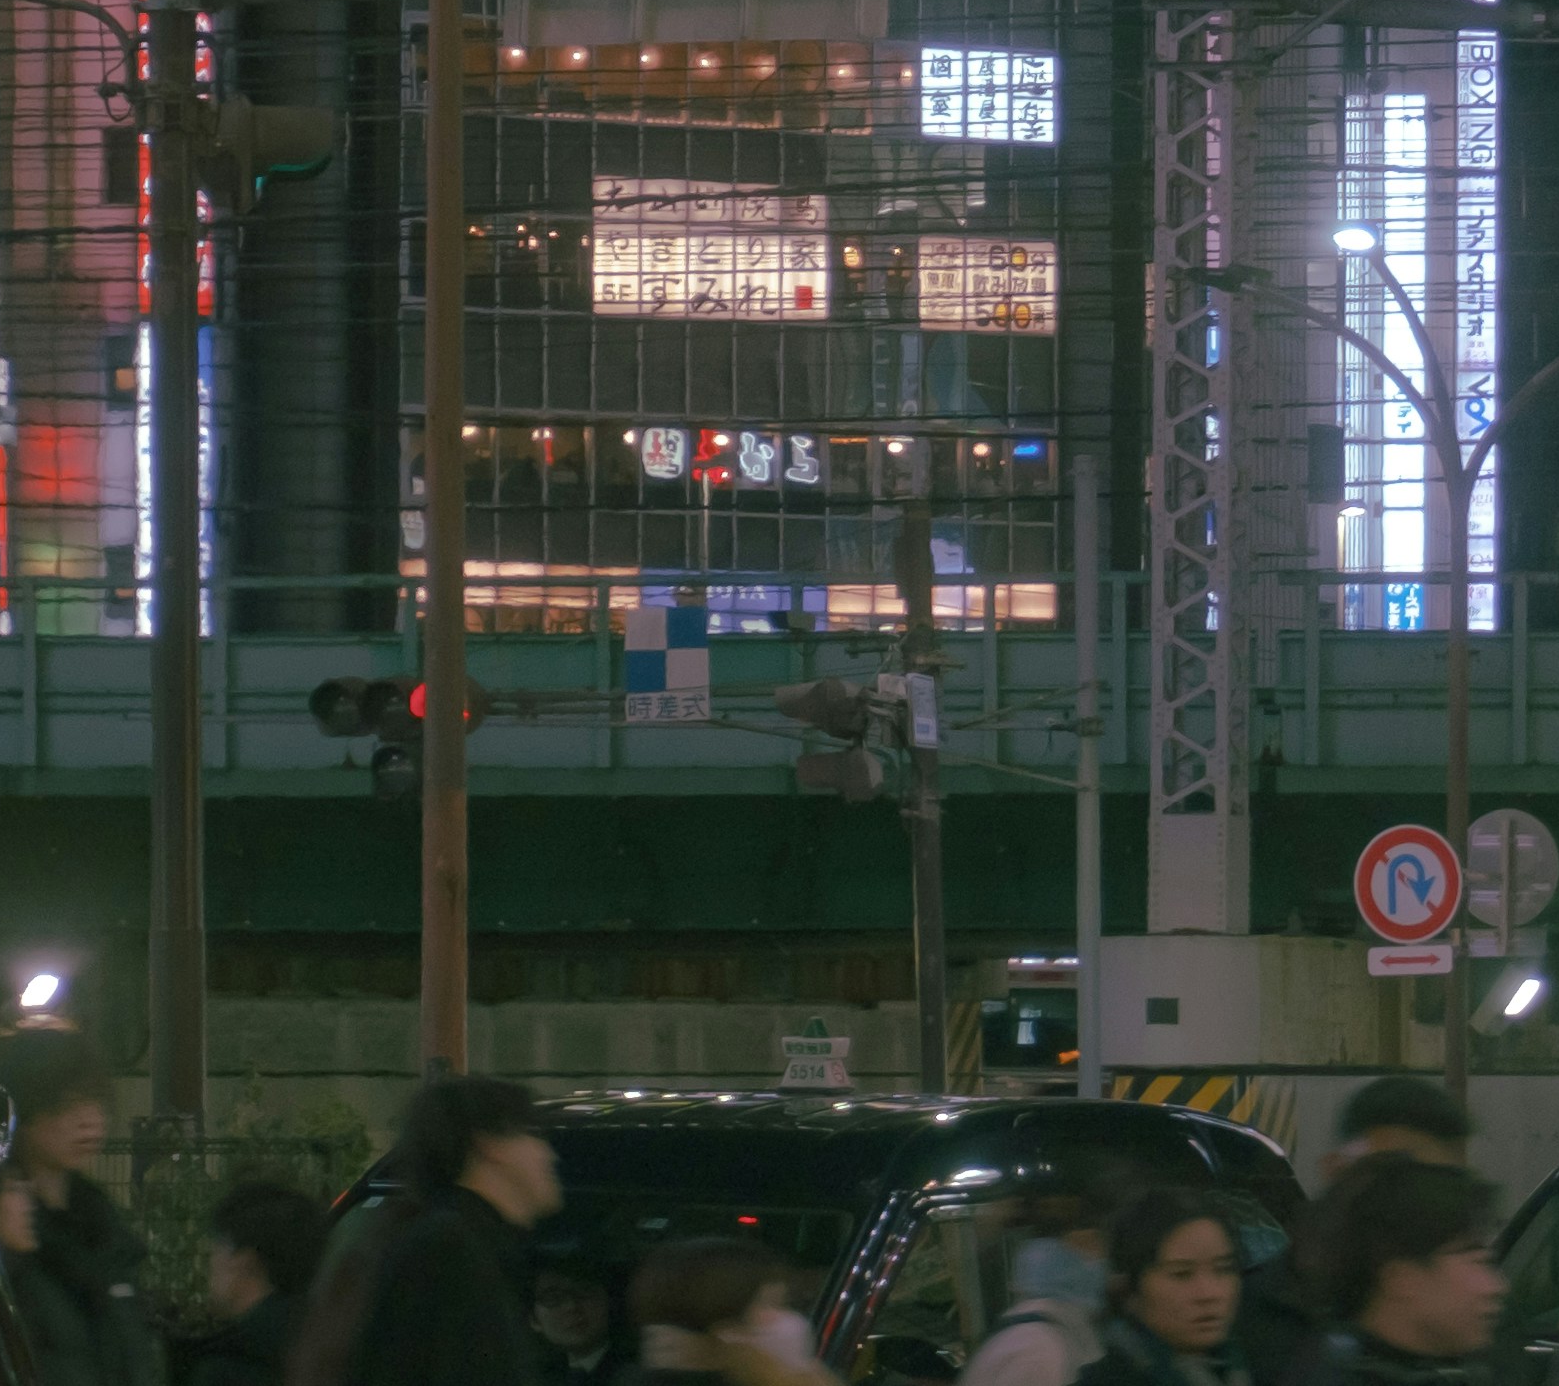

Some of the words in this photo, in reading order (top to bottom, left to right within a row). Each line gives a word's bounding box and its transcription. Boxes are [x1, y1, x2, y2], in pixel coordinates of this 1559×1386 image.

[1470, 43, 1494, 165] BOXING
[628, 693, 708, 719] 時差式
